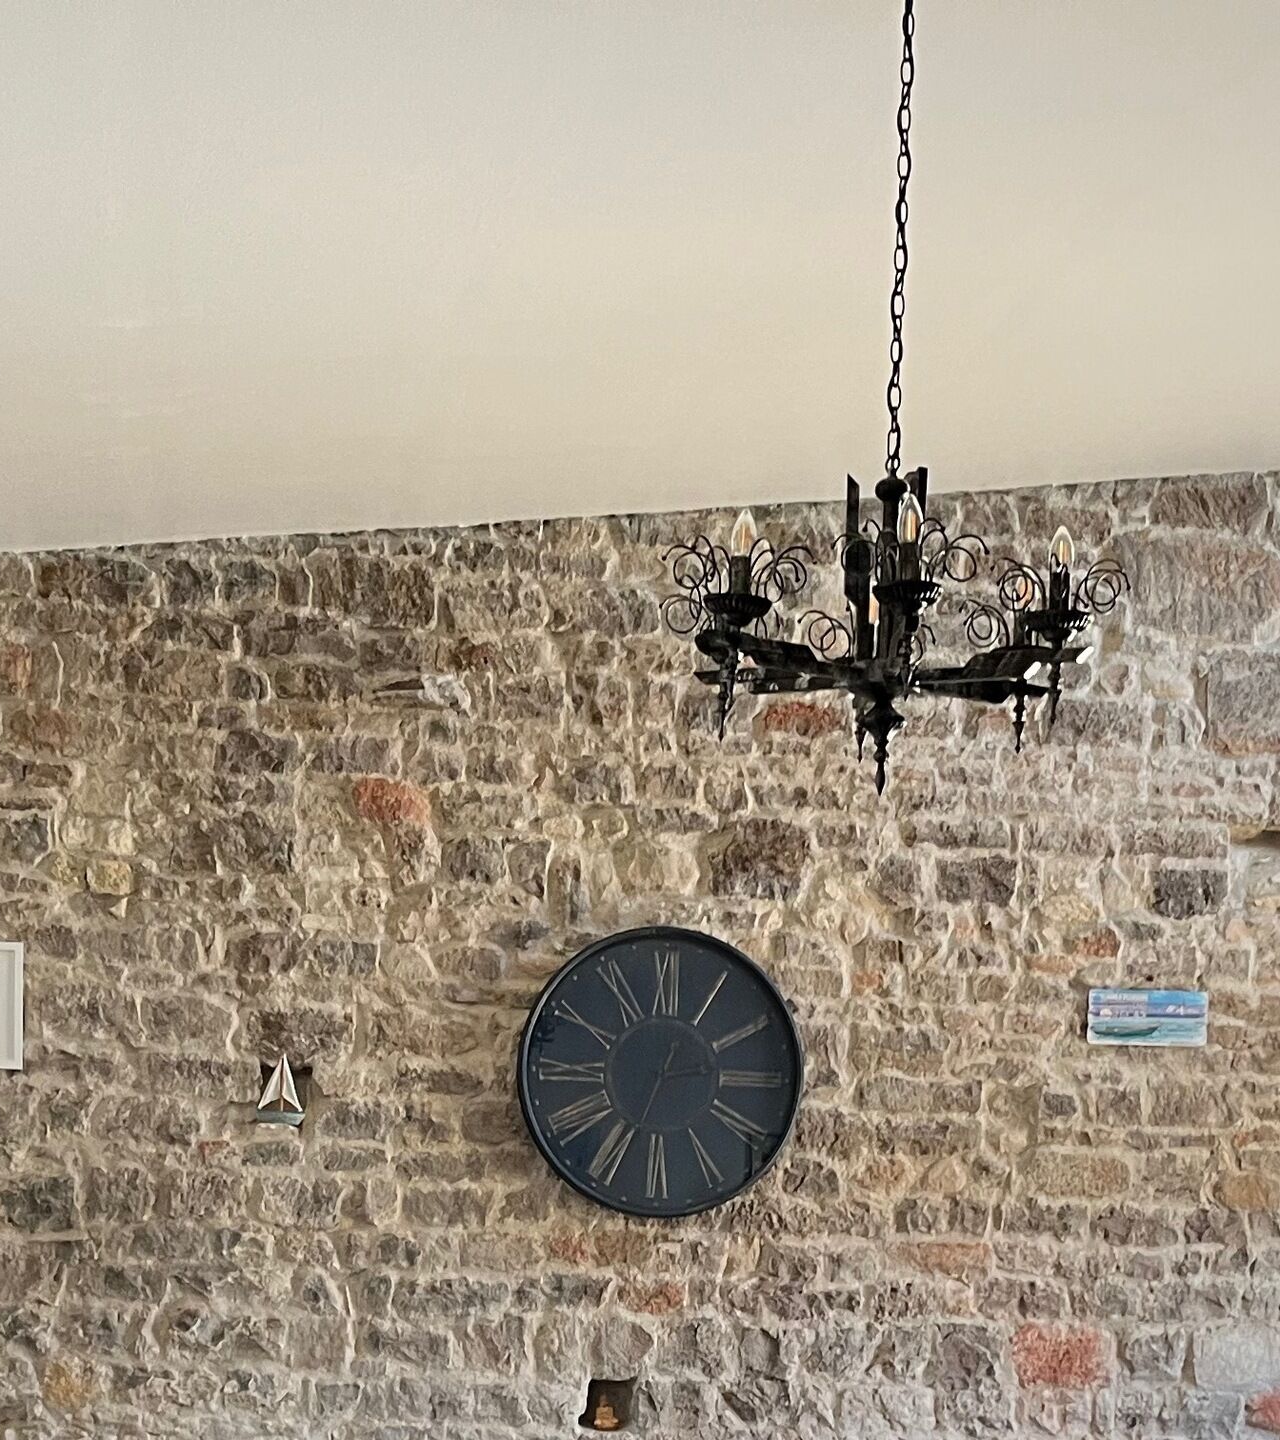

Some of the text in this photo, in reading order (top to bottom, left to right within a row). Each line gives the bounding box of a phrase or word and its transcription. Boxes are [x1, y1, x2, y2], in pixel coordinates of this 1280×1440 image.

[596, 959, 646, 1028] XI
[652, 951, 680, 1017] XII
[692, 970, 728, 1027] I
[554, 1000, 617, 1049] X
[539, 1057, 605, 1084] IX
[645, 1133, 669, 1199] VI
[687, 1126, 725, 1188] V
